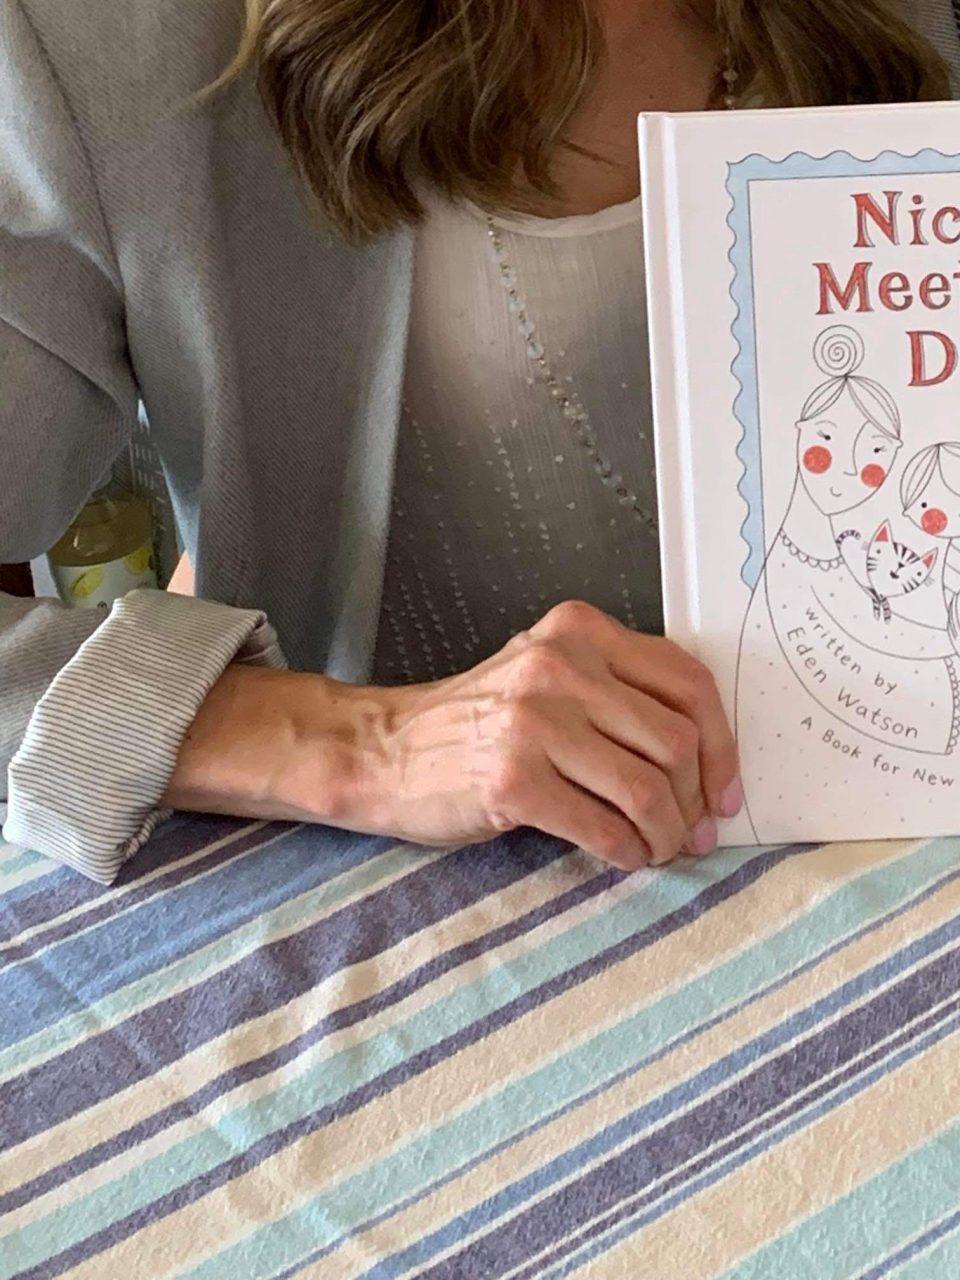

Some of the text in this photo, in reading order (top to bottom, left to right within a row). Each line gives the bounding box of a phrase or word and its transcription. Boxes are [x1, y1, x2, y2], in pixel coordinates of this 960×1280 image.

[786, 626, 918, 739] Eden Watson
[805, 607, 898, 695] written by
[801, 716, 813, 731] A
[822, 728, 862, 759] Book
[873, 754, 901, 775] for
[913, 767, 955, 788] New
